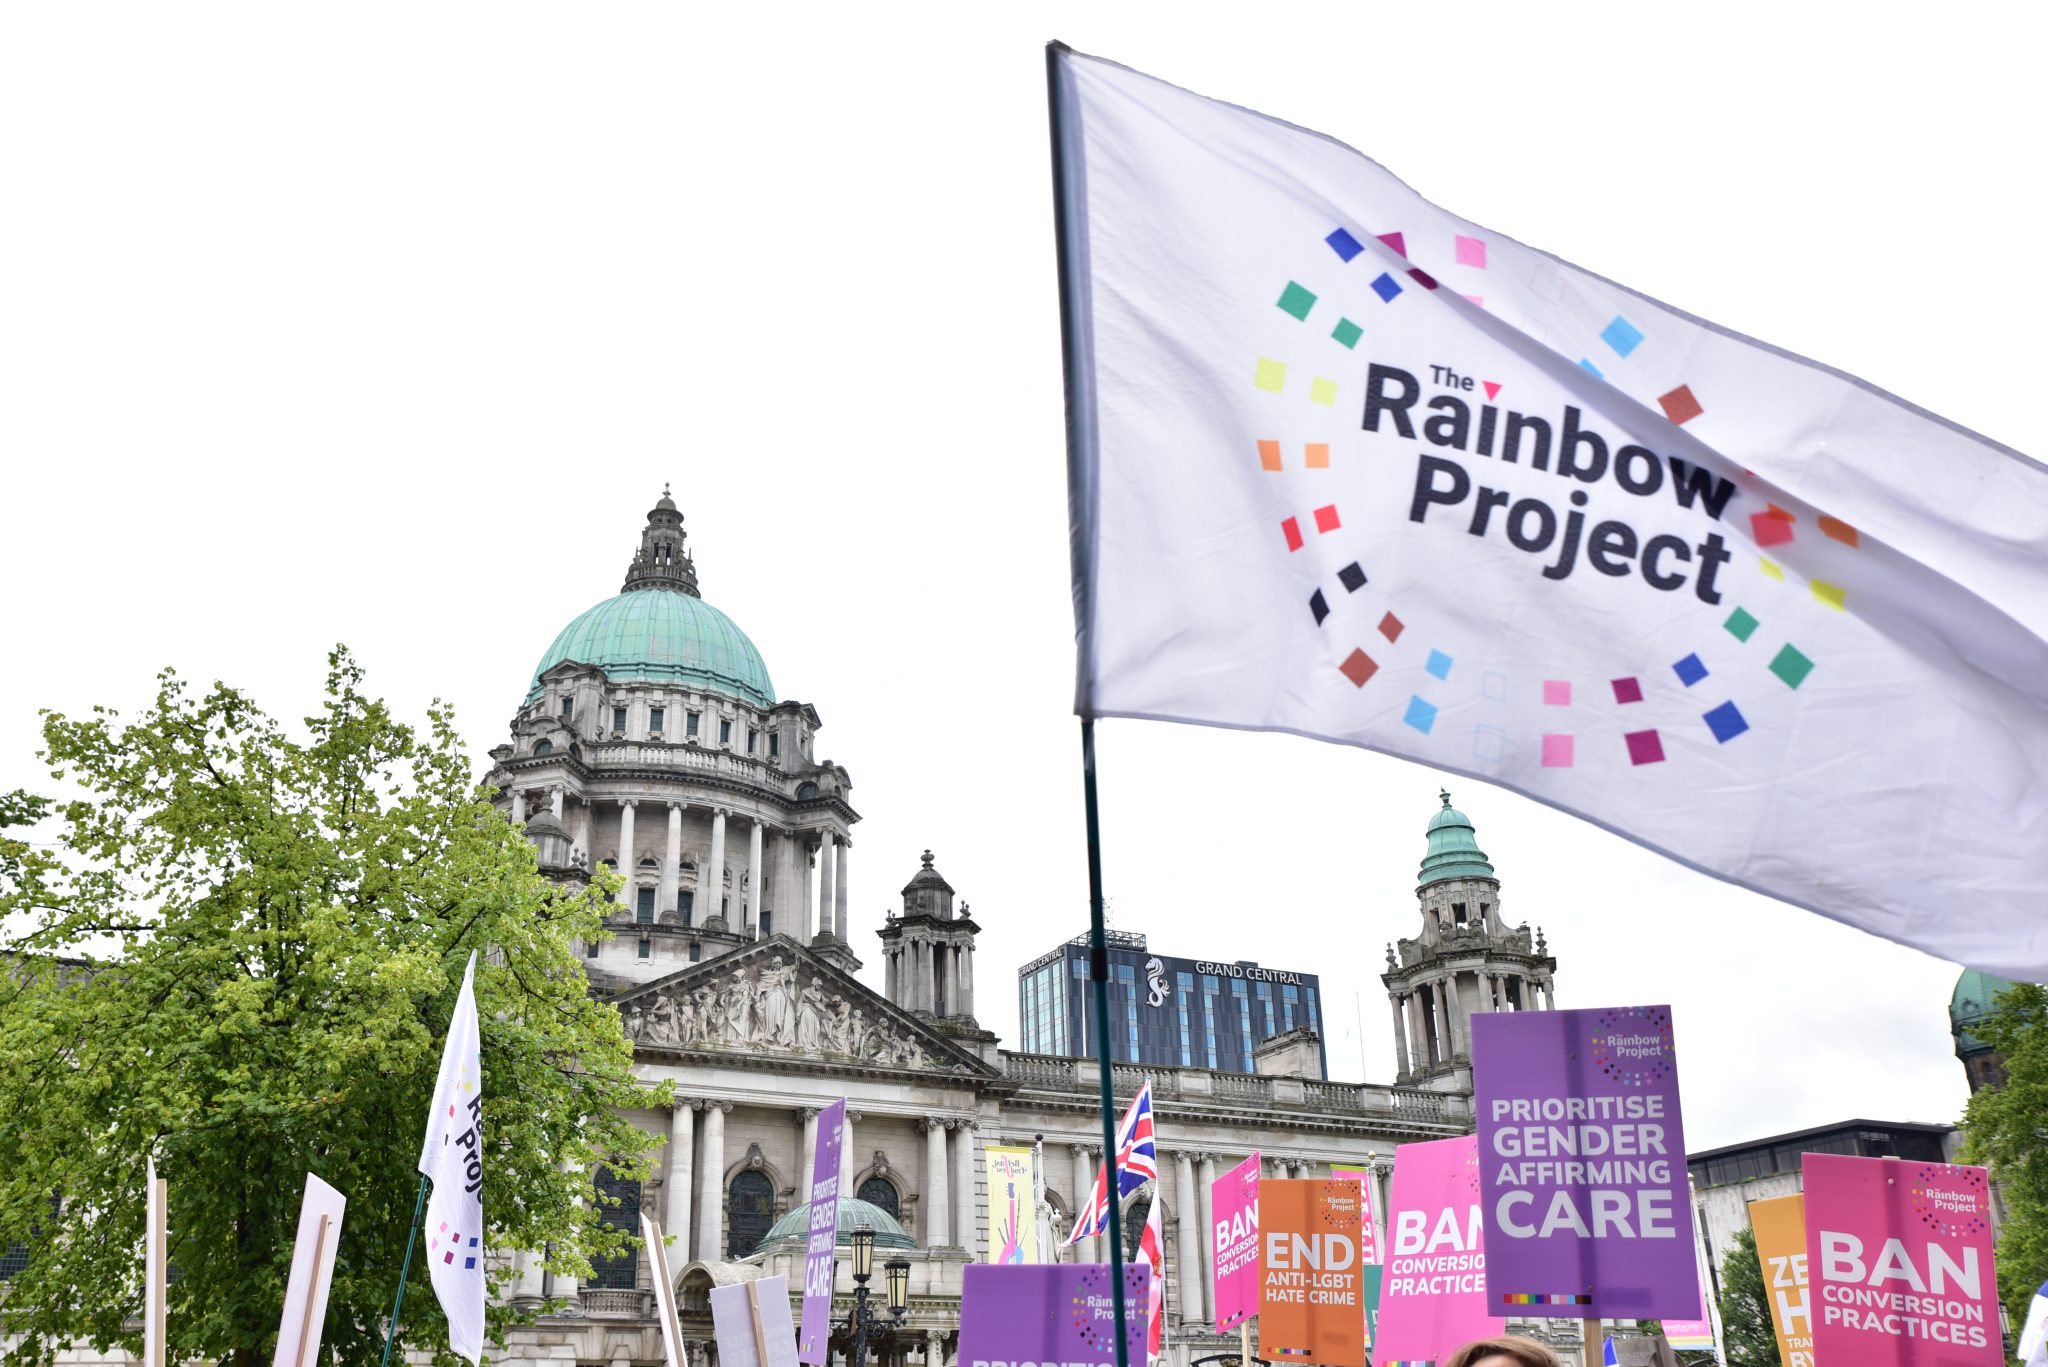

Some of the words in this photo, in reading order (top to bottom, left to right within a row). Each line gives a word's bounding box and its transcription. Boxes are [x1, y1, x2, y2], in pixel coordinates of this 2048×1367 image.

[1429, 364, 1474, 391] The
[1361, 362, 1737, 521] Rainbow
[1409, 453, 1731, 605] Project
[1019, 961, 1038, 977] GRAND
[1038, 949, 1063, 967] CENTRAL
[1195, 961, 1243, 978] GRAND
[1246, 967, 1303, 986] CENTRAL
[1607, 1034, 1660, 1046] Rainbow
[1617, 1045, 1662, 1059] Project
[1492, 1095, 1665, 1122] PRIORITISE
[1493, 1123, 1668, 1157] GENDER
[1495, 1160, 1671, 1185] AFFIRMING
[1331, 1204, 1355, 1212] Project
[1926, 1188, 1976, 1202] Rainbow
[1935, 1199, 1977, 1213] Project
[811, 1200, 835, 1232] GENDER
[1216, 1198, 1259, 1254] BAN
[1495, 1189, 1676, 1238] CARE
[1266, 1232, 1355, 1271] END
[1391, 1253, 1486, 1275] CONVERSIO
[1819, 1230, 1982, 1300] BAN
[806, 1255, 831, 1298] CARE
[1265, 1271, 1354, 1289] ANTI-LGBT
[1768, 1253, 1809, 1288] ZE
[1265, 1288, 1305, 1303] HATE
[1309, 1290, 1356, 1306] CRIME
[1389, 1273, 1486, 1296] PRACTICE
[1822, 1285, 1984, 1323] CONVERSION
[1823, 1305, 1988, 1348] PRACTICES
